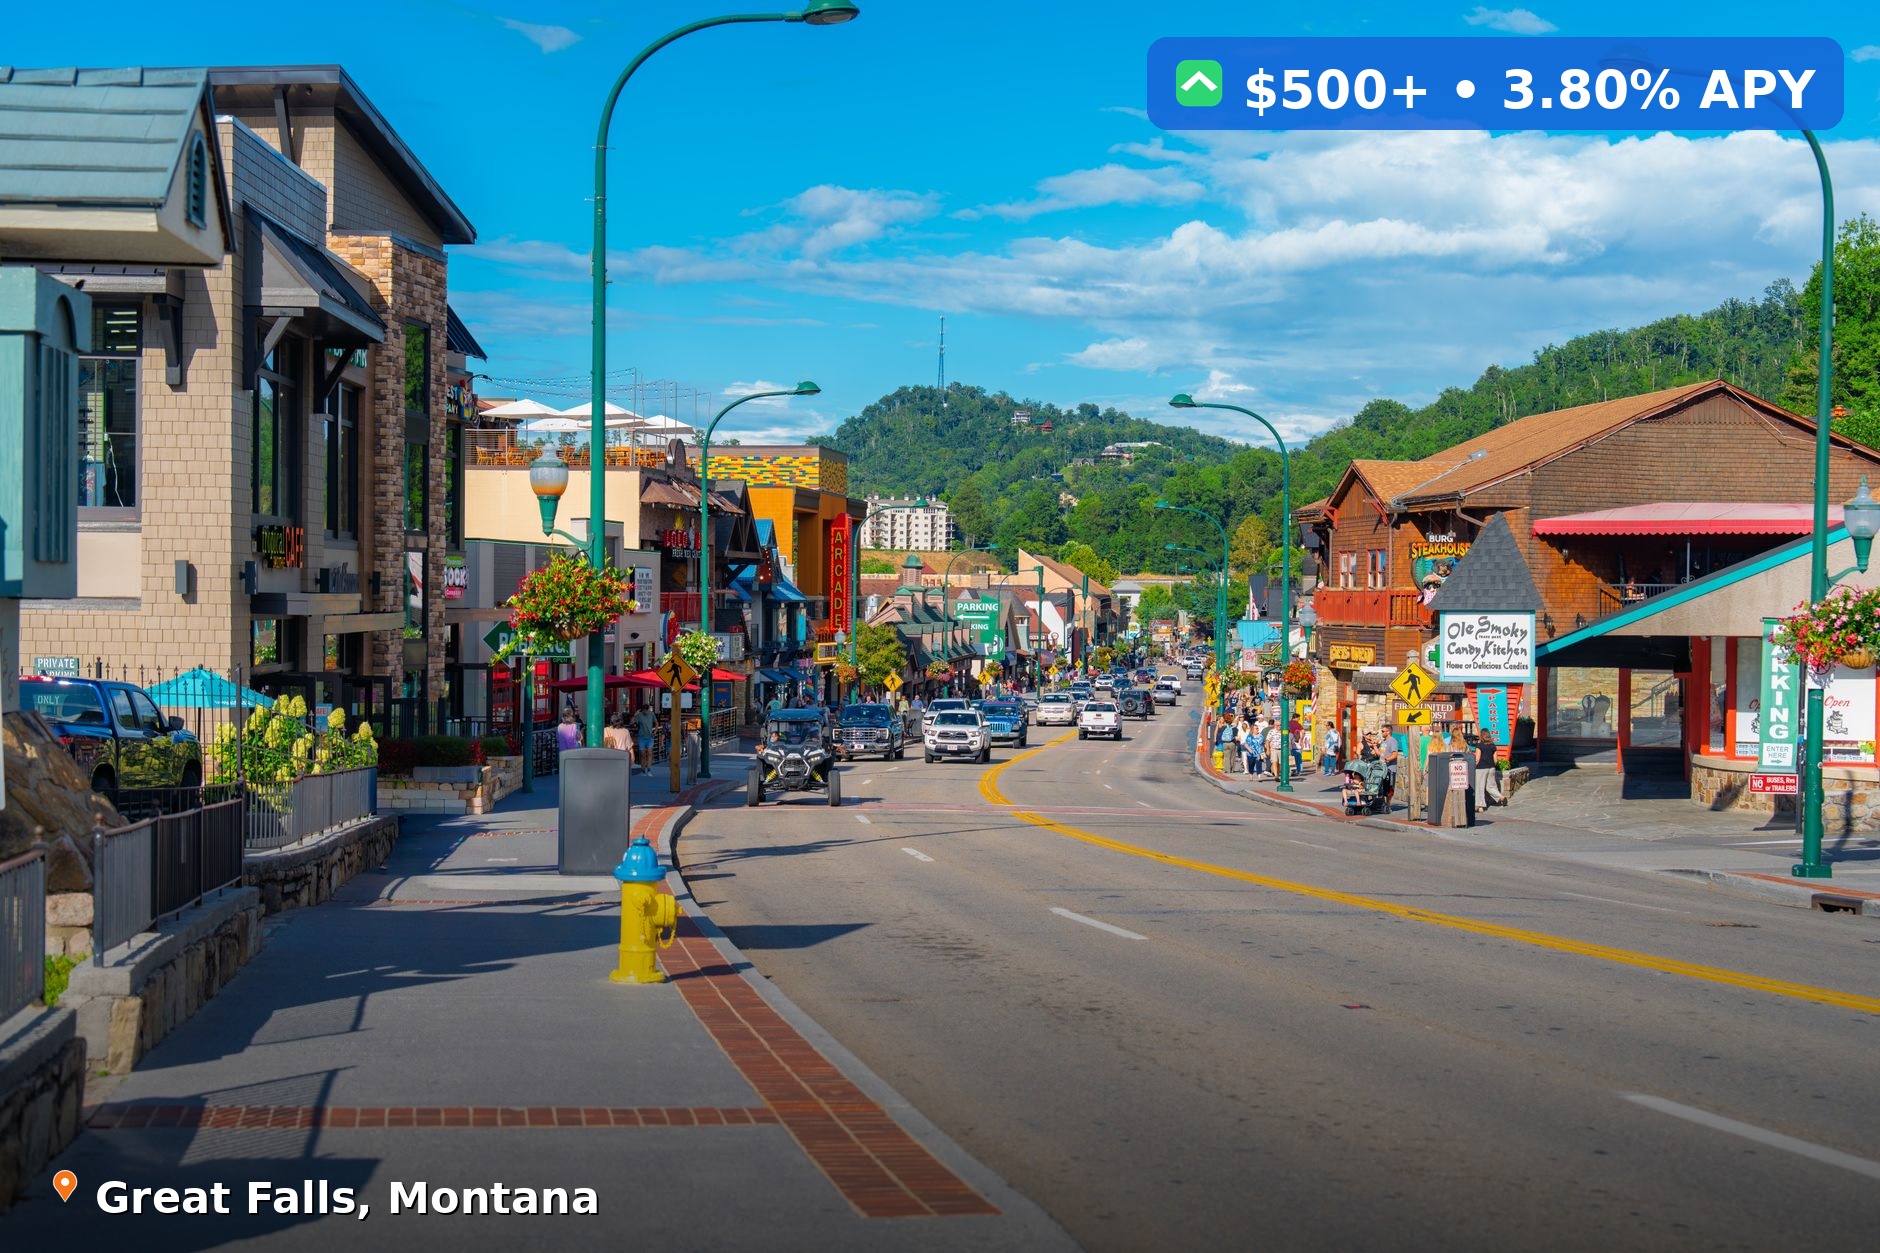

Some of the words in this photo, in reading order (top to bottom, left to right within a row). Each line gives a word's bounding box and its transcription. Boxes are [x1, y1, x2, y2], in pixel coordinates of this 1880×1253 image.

[1429, 534, 1454, 543] BURG
[285, 526, 304, 569] CAFE
[833, 530, 843, 627] ARCADE
[957, 602, 999, 611] PARKING
[1447, 621, 1475, 640] Ole
[1475, 615, 1528, 645] Smoky
[1447, 641, 1482, 662] Candy
[1480, 640, 1528, 664] Kitchen
[37, 658, 75, 669] PRIVATE
[1446, 661, 1463, 670] Home
[1472, 661, 1502, 670] Delicious
[1503, 661, 1529, 670] Candies
[37, 695, 60, 705] ONLY
[1823, 695, 1851, 709] Open
[1419, 703, 1453, 712] UNITED
[1488, 695, 1500, 742] PARKING
[1766, 745, 1789, 753] ENTER
[1752, 779, 1763, 789] NO
[1766, 776, 1786, 784] BUSES,
